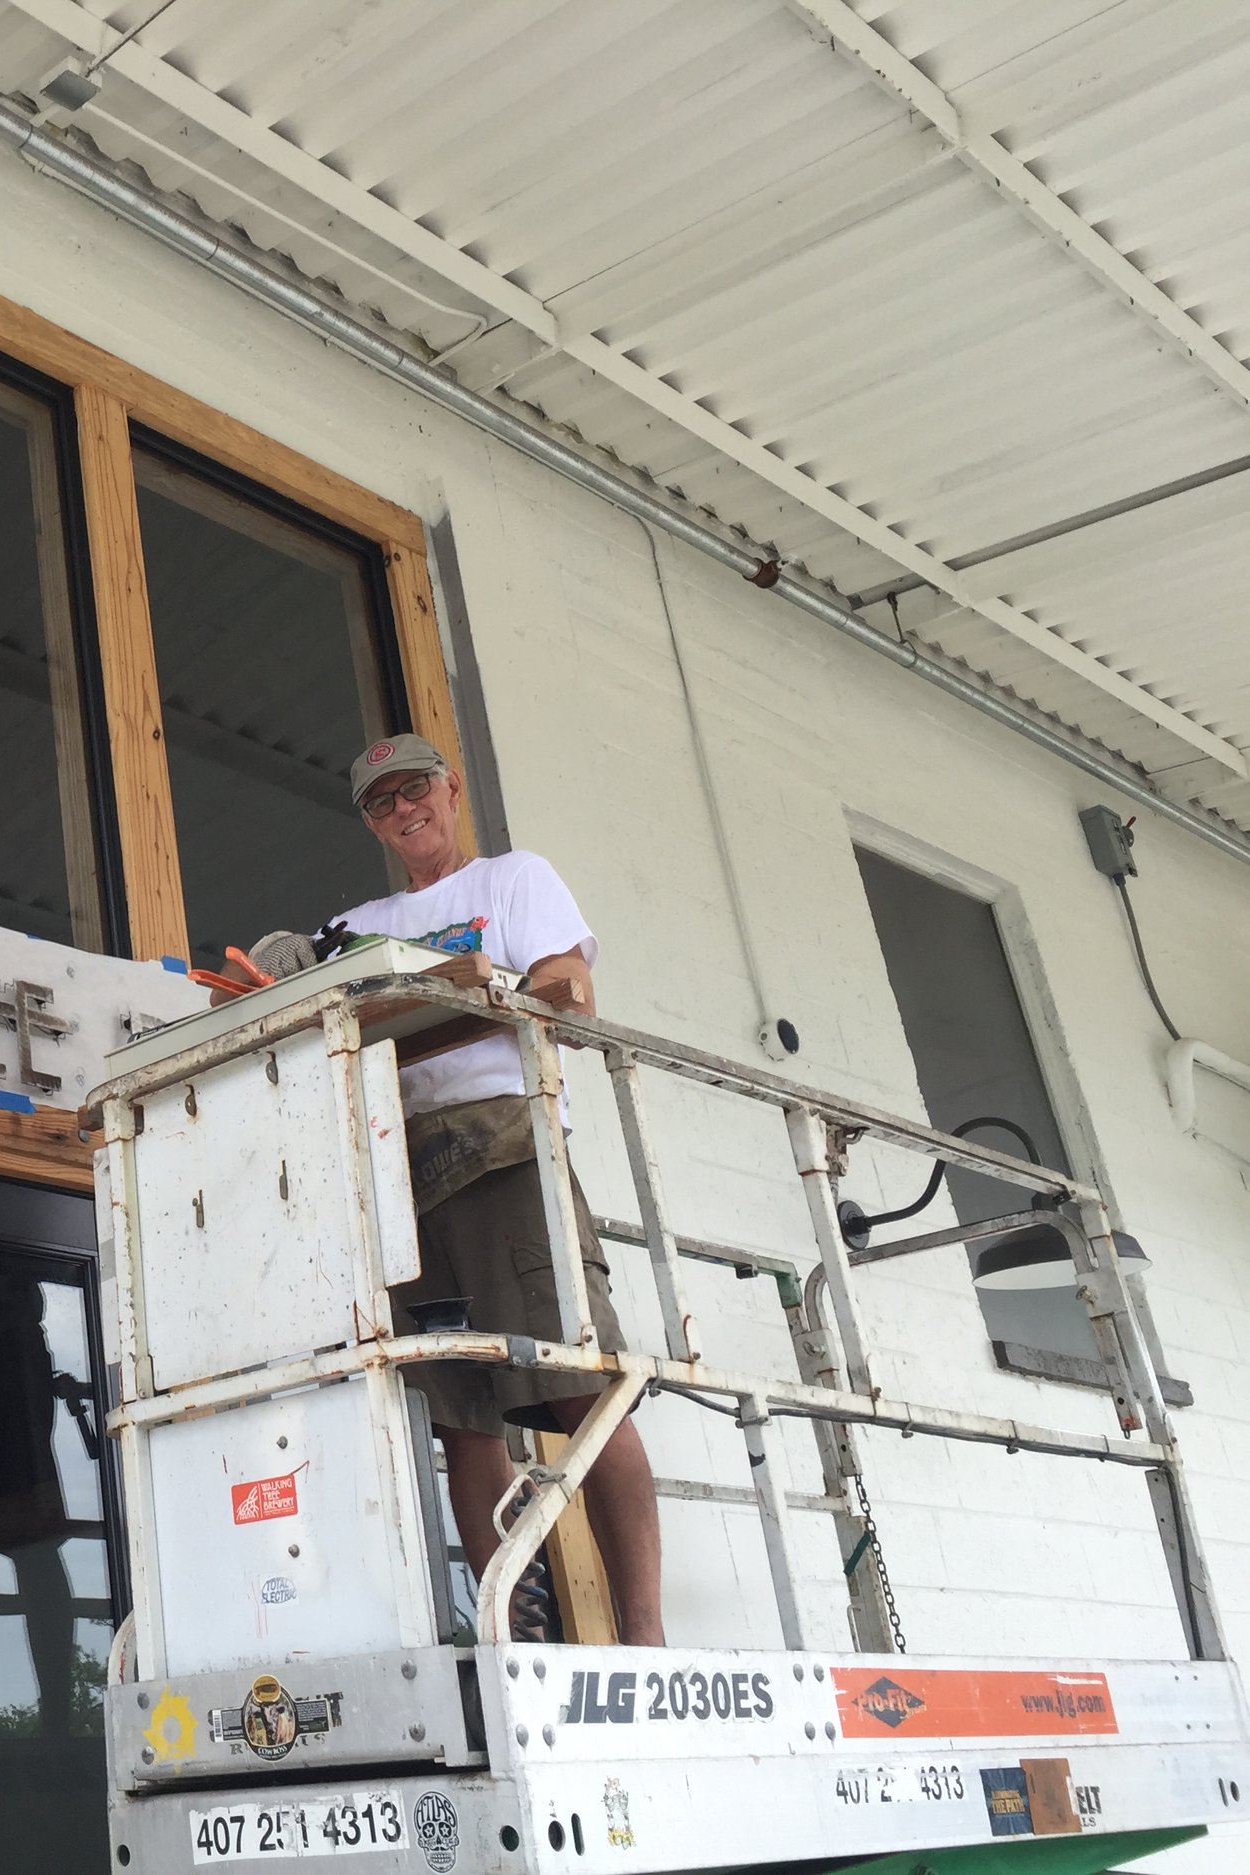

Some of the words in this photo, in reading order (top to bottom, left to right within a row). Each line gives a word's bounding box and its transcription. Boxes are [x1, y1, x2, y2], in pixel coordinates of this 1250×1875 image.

[414, 1136, 474, 1185] OWE'S
[260, 1478, 293, 1491] WALKING
[262, 1490, 281, 1500] TREE
[263, 1497, 295, 1511] BREWERY
[262, 1589, 297, 1603] ELECTRIC
[266, 1577, 290, 1591] TOTAL
[560, 1671, 637, 1723] JLG
[646, 1671, 774, 1720] 2030ES
[1020, 1689, 1106, 1719] www.jlg.com
[921, 1765, 964, 1800] 4313
[416, 1795, 456, 1830] ATLAS
[197, 1813, 246, 1856] 407
[323, 1801, 402, 1846] 4313
